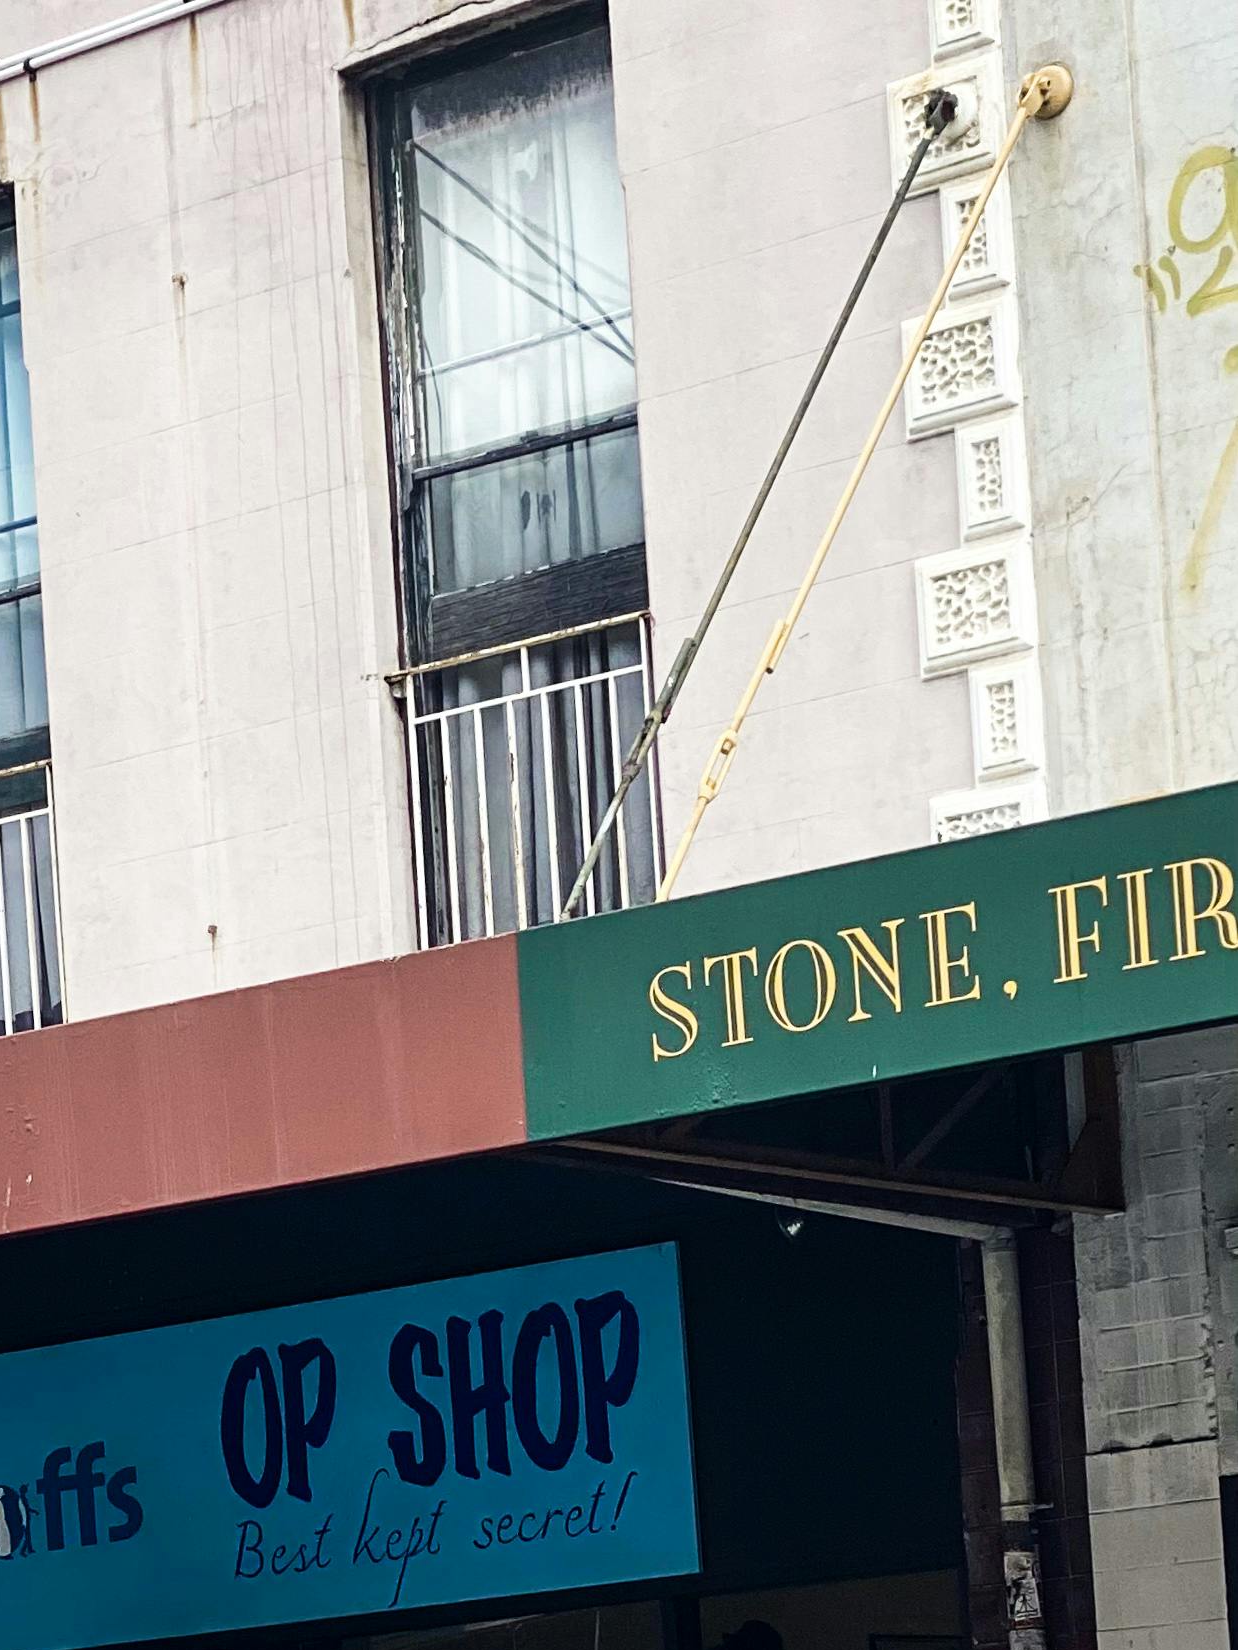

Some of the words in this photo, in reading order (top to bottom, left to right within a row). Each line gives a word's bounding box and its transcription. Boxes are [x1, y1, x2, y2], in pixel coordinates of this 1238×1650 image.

[648, 901, 1018, 1062] STONE,
[1048, 857, 1238, 983] FIR
[220, 1337, 336, 1508] OP
[387, 1289, 640, 1487] SHOP
[234, 1513, 332, 1581] Best
[354, 1467, 446, 1608] kept
[473, 1471, 638, 1551] secret!
